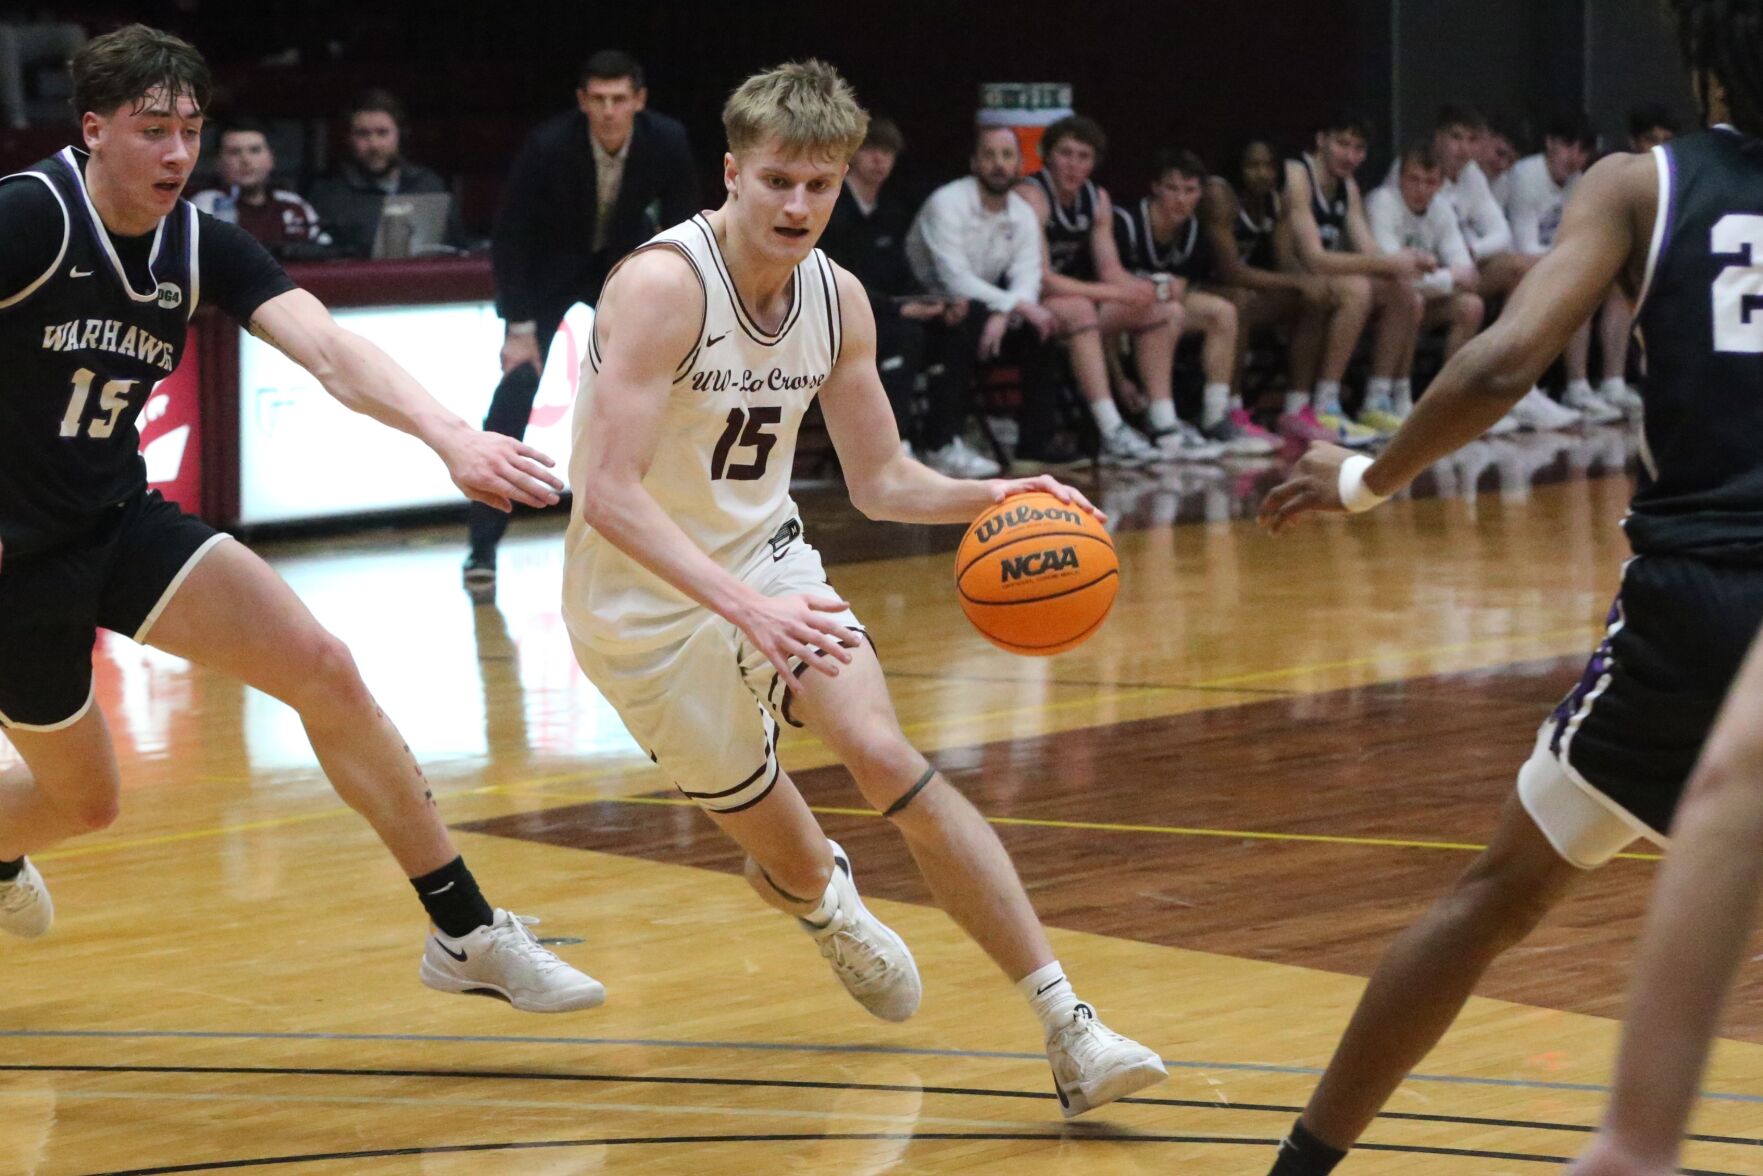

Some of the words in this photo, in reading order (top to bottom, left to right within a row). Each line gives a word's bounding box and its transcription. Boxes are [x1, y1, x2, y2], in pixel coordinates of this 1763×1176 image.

[1711, 214, 1763, 353] 2
[59, 368, 140, 439] 15
[767, 368, 825, 391] Crosse
[711, 406, 782, 480] 15
[974, 505, 1082, 543] Wilson
[1001, 545, 1079, 582] NCAA
